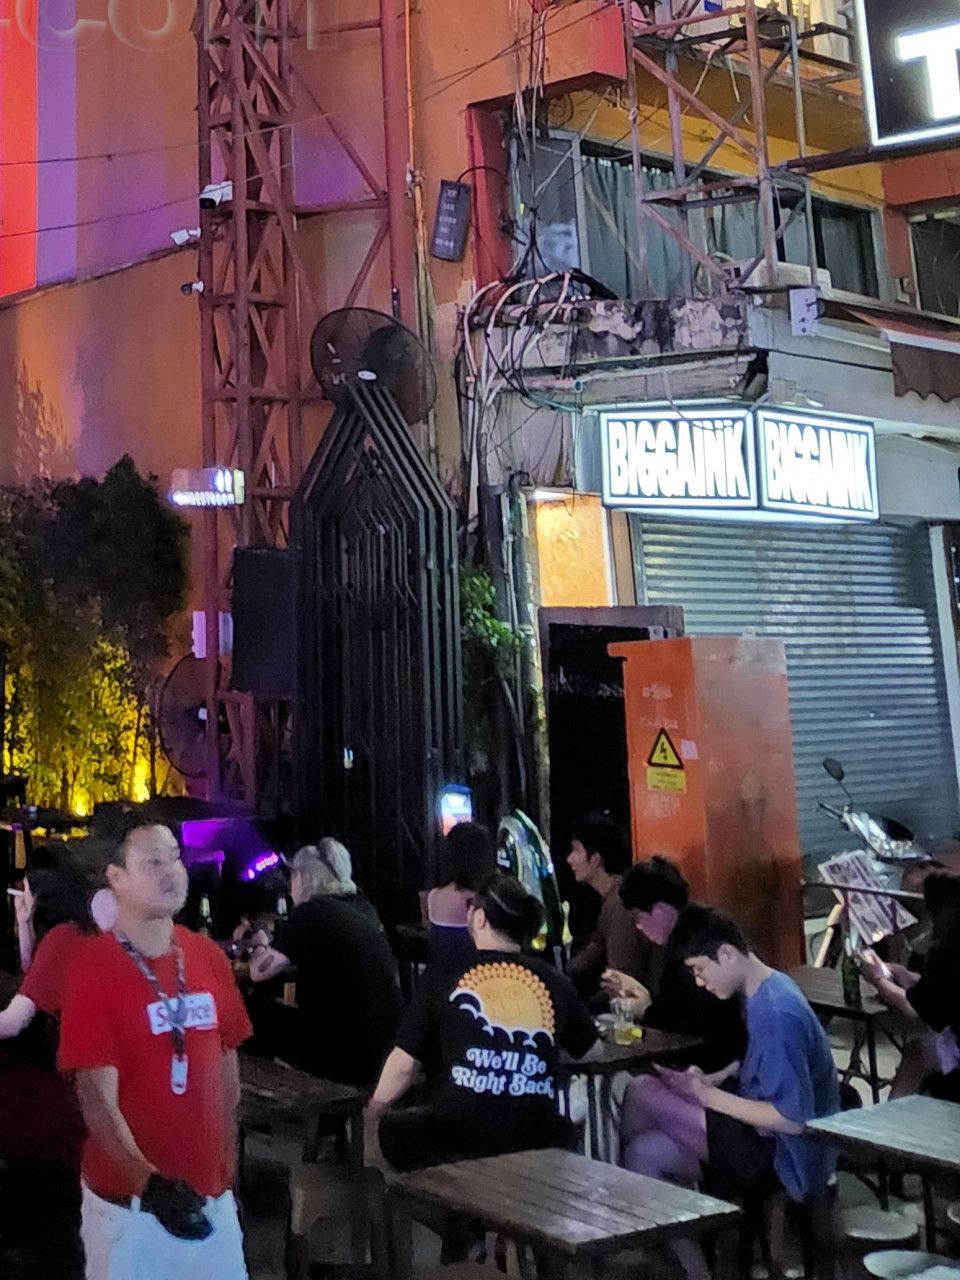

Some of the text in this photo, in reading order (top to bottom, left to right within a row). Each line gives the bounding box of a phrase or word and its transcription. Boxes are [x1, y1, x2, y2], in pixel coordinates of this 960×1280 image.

[466, 1047, 547, 1077] We'll Be
[451, 1065, 555, 1100] Right Back
